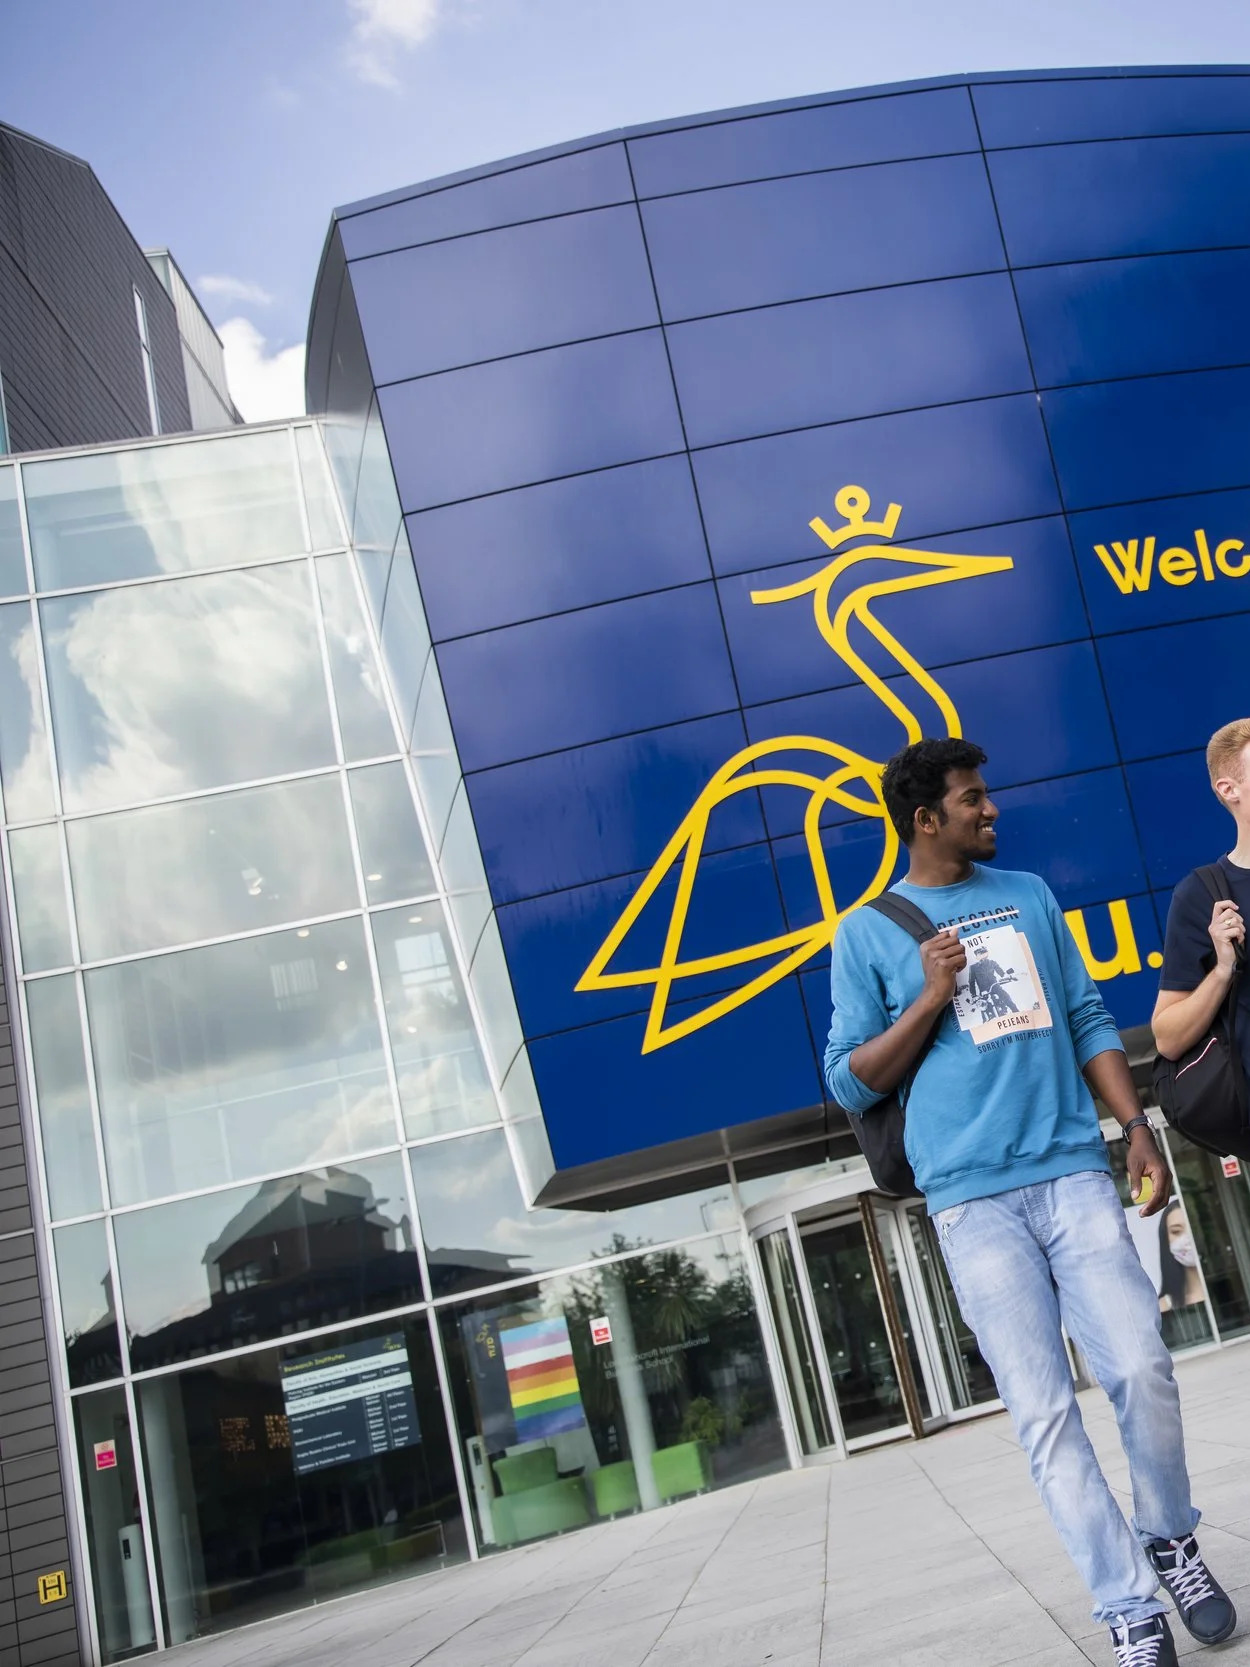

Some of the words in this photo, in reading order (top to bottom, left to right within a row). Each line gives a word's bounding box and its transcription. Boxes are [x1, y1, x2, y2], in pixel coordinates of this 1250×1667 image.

[967, 936, 984, 948] NOT
[1064, 899, 1164, 981] u.
[997, 1015, 1030, 1029] PEJEANS
[284, 1361, 313, 1372] Research
[42, 1574, 62, 1600] H
